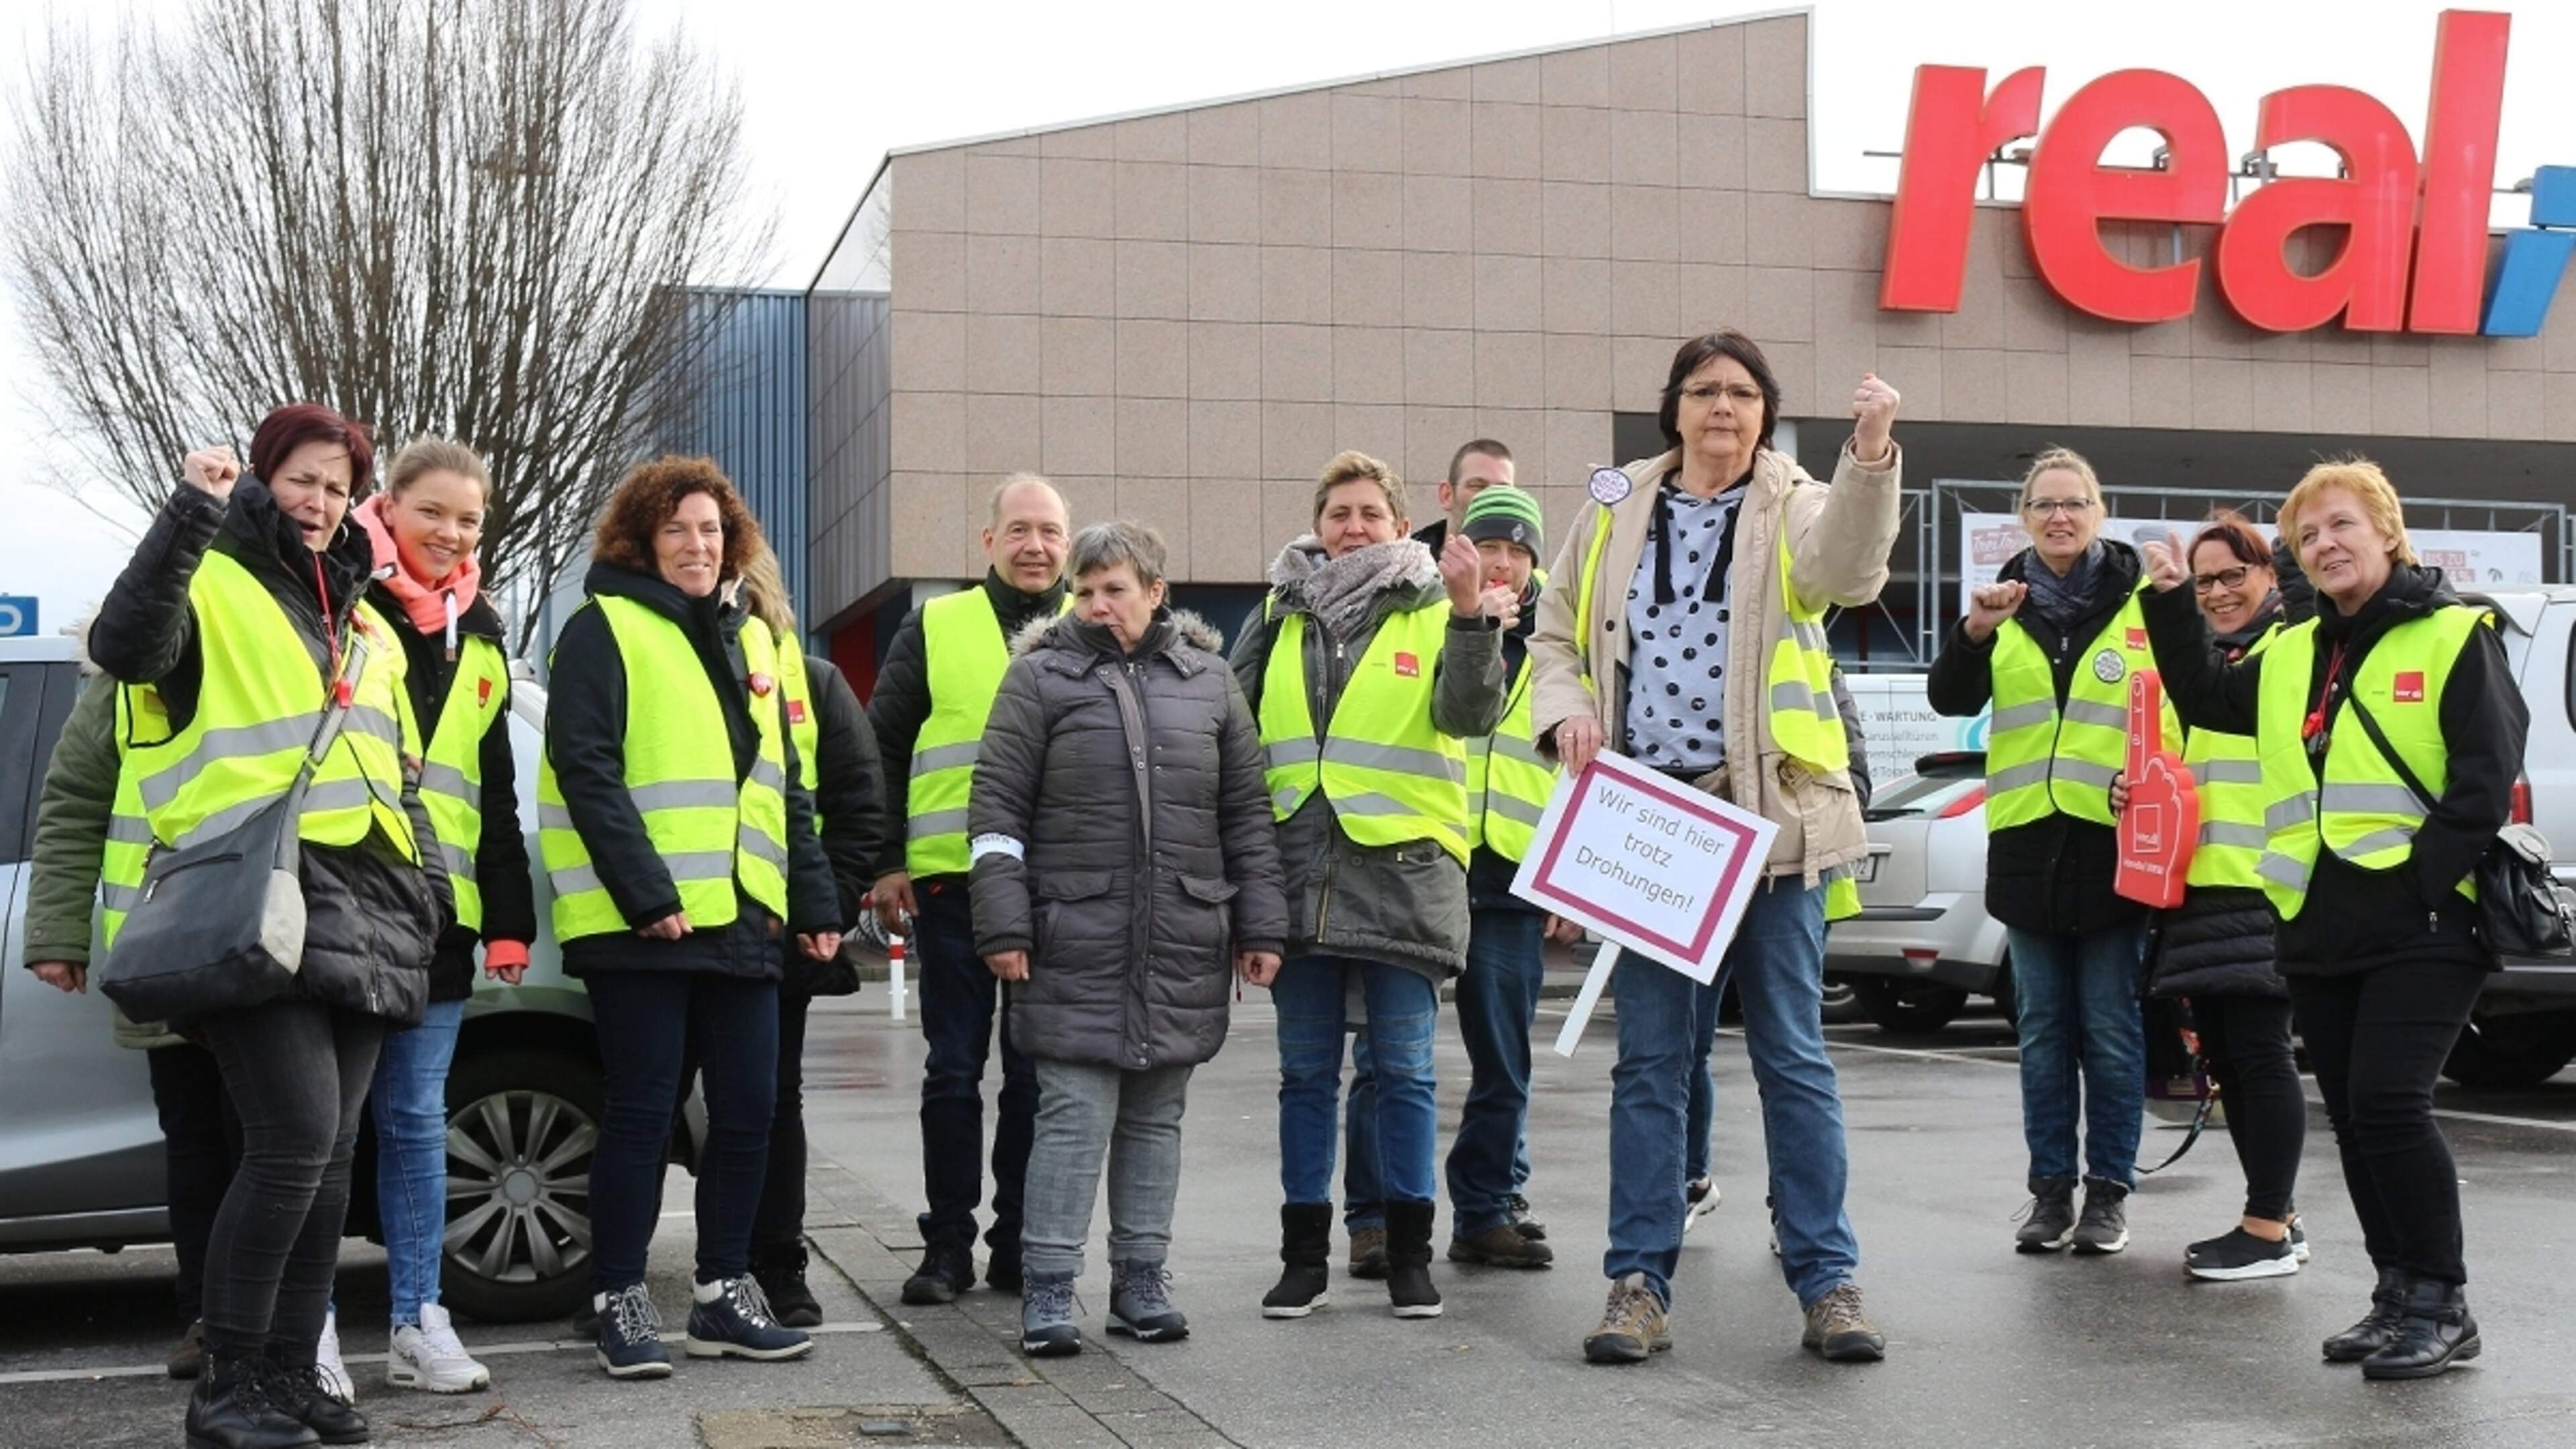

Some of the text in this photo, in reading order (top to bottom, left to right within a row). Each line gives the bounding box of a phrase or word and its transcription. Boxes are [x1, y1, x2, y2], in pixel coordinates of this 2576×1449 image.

[1875, 711, 1937, 722] WARTUNG
[1599, 786, 1725, 855] Wir sind hier
[1624, 832, 1672, 868] trotz
[1575, 845, 1695, 913] Drohungen!
